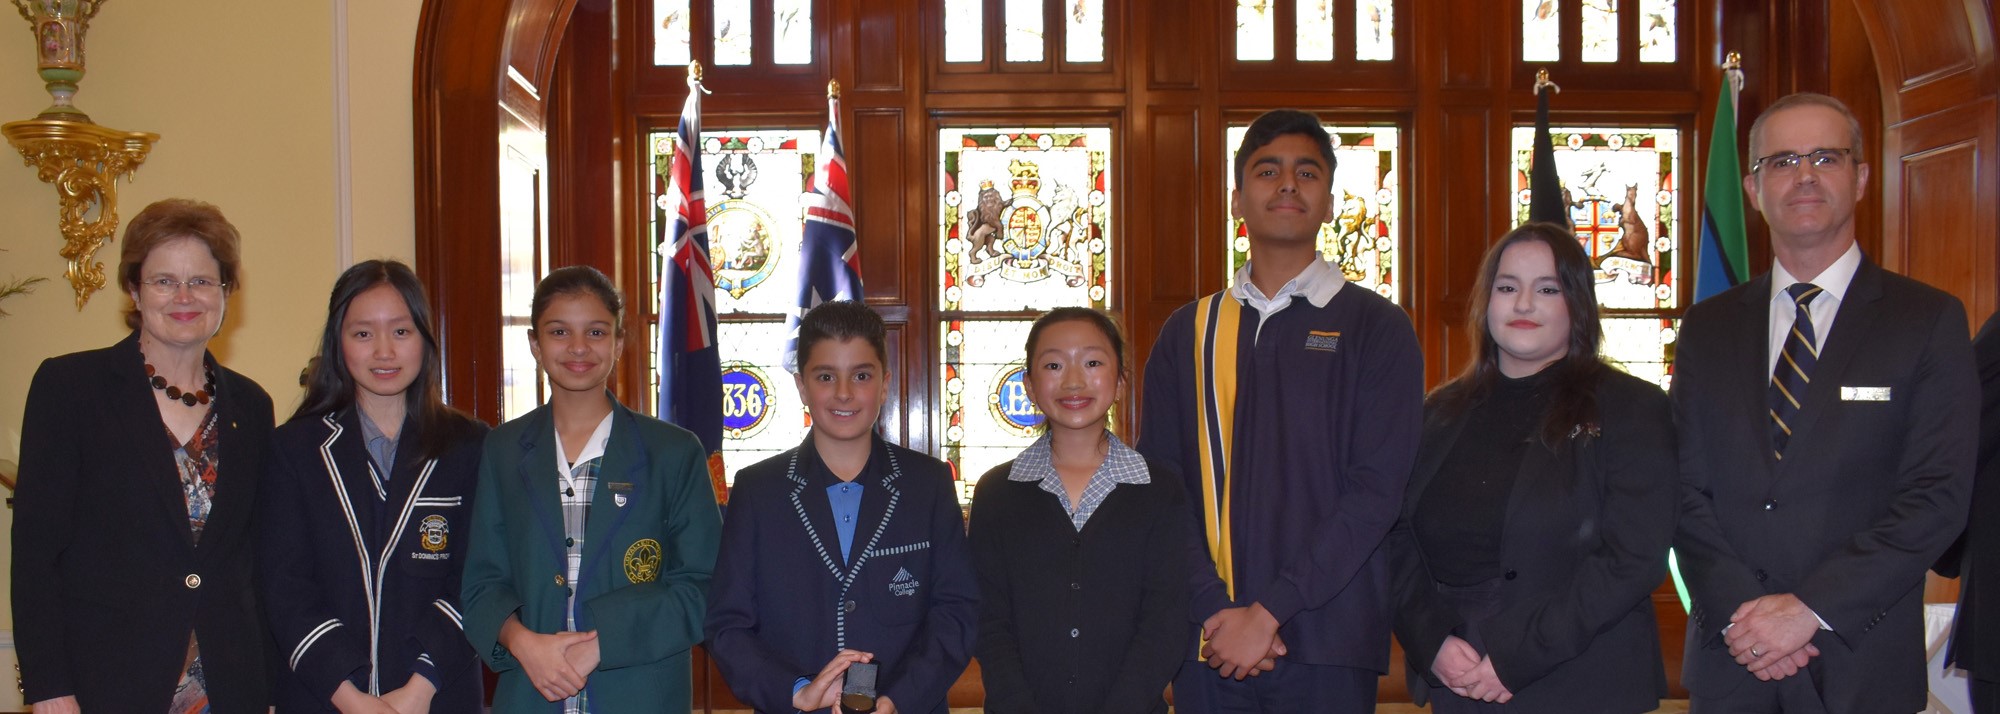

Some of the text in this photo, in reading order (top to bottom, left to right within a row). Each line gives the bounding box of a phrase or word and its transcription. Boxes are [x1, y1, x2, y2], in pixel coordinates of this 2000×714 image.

[1004, 267, 1015, 277] ET
[889, 579, 920, 591] Pinnacle
[895, 588, 915, 596] College
